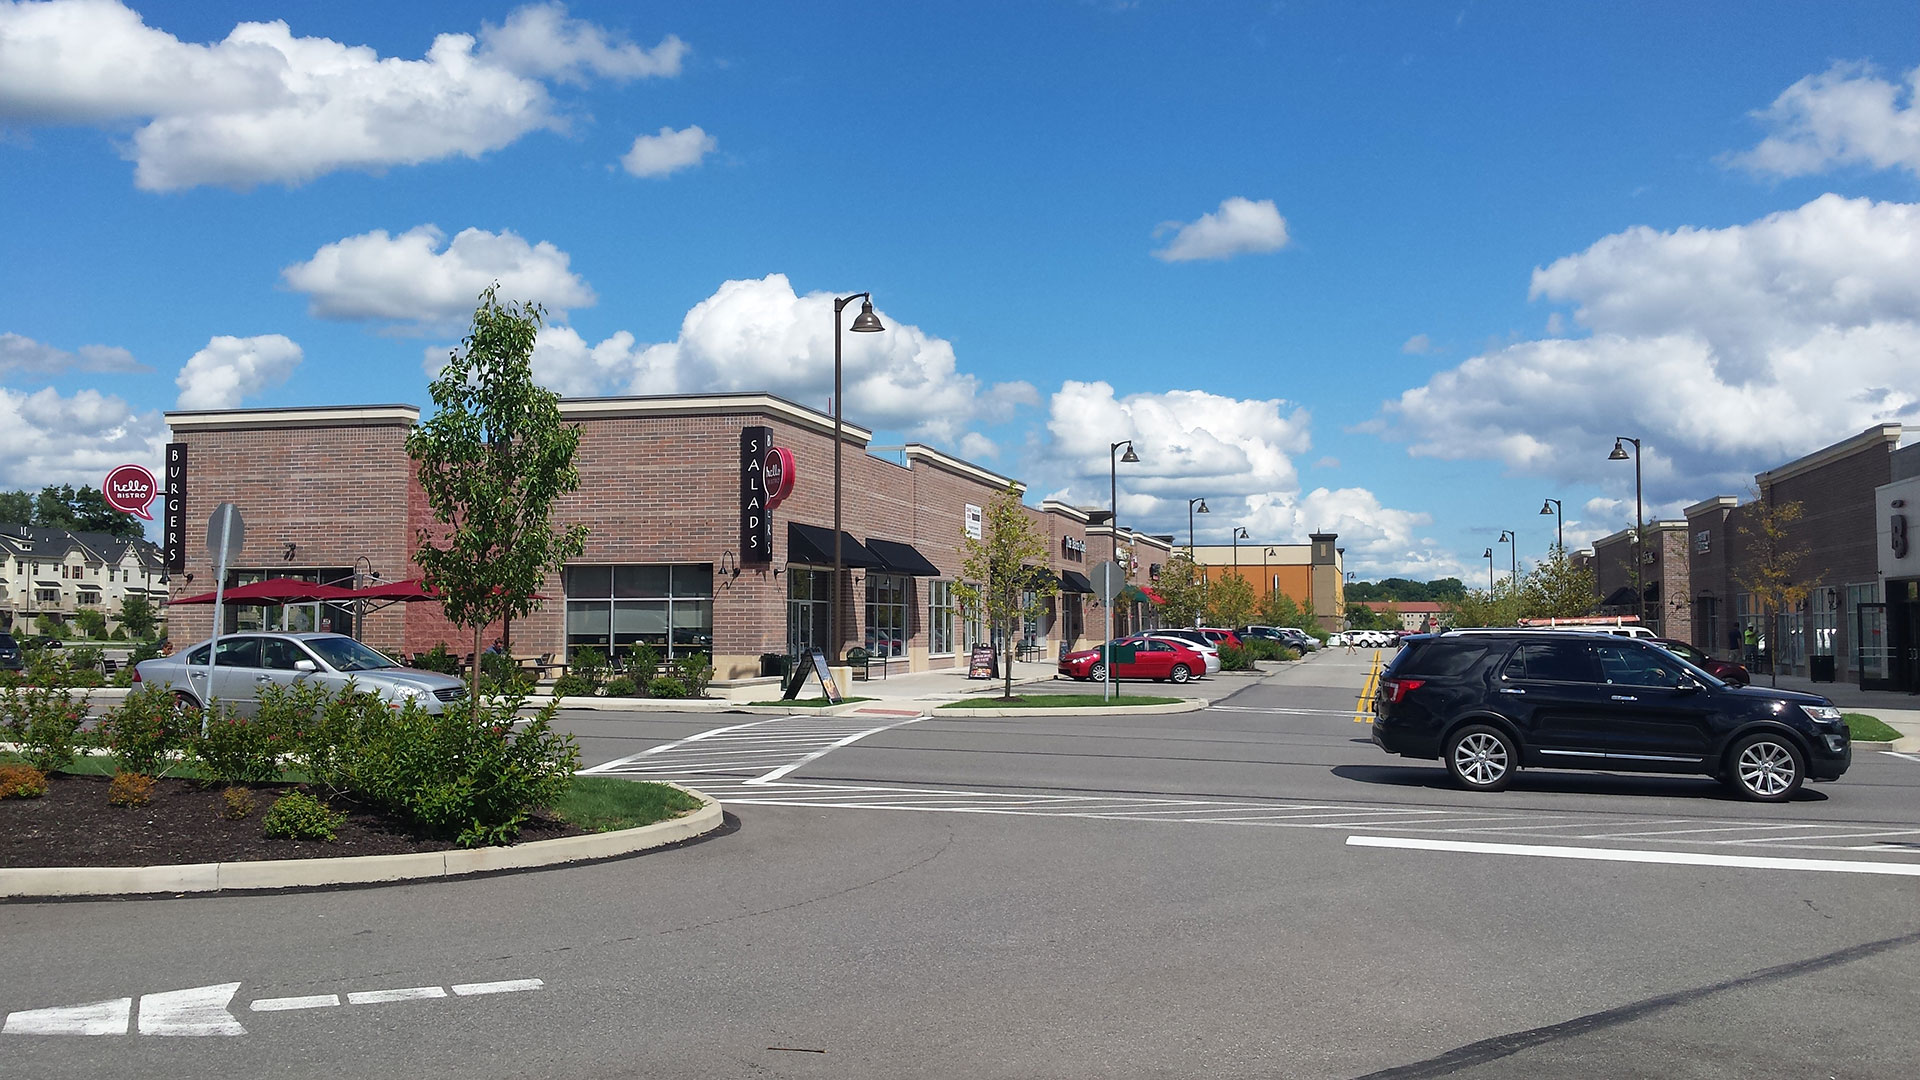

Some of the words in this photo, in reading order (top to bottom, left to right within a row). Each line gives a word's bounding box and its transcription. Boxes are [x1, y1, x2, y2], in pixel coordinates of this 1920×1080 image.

[113, 479, 149, 492] hello
[169, 450, 180, 561] BURGERS
[747, 440, 760, 548] SALADS
